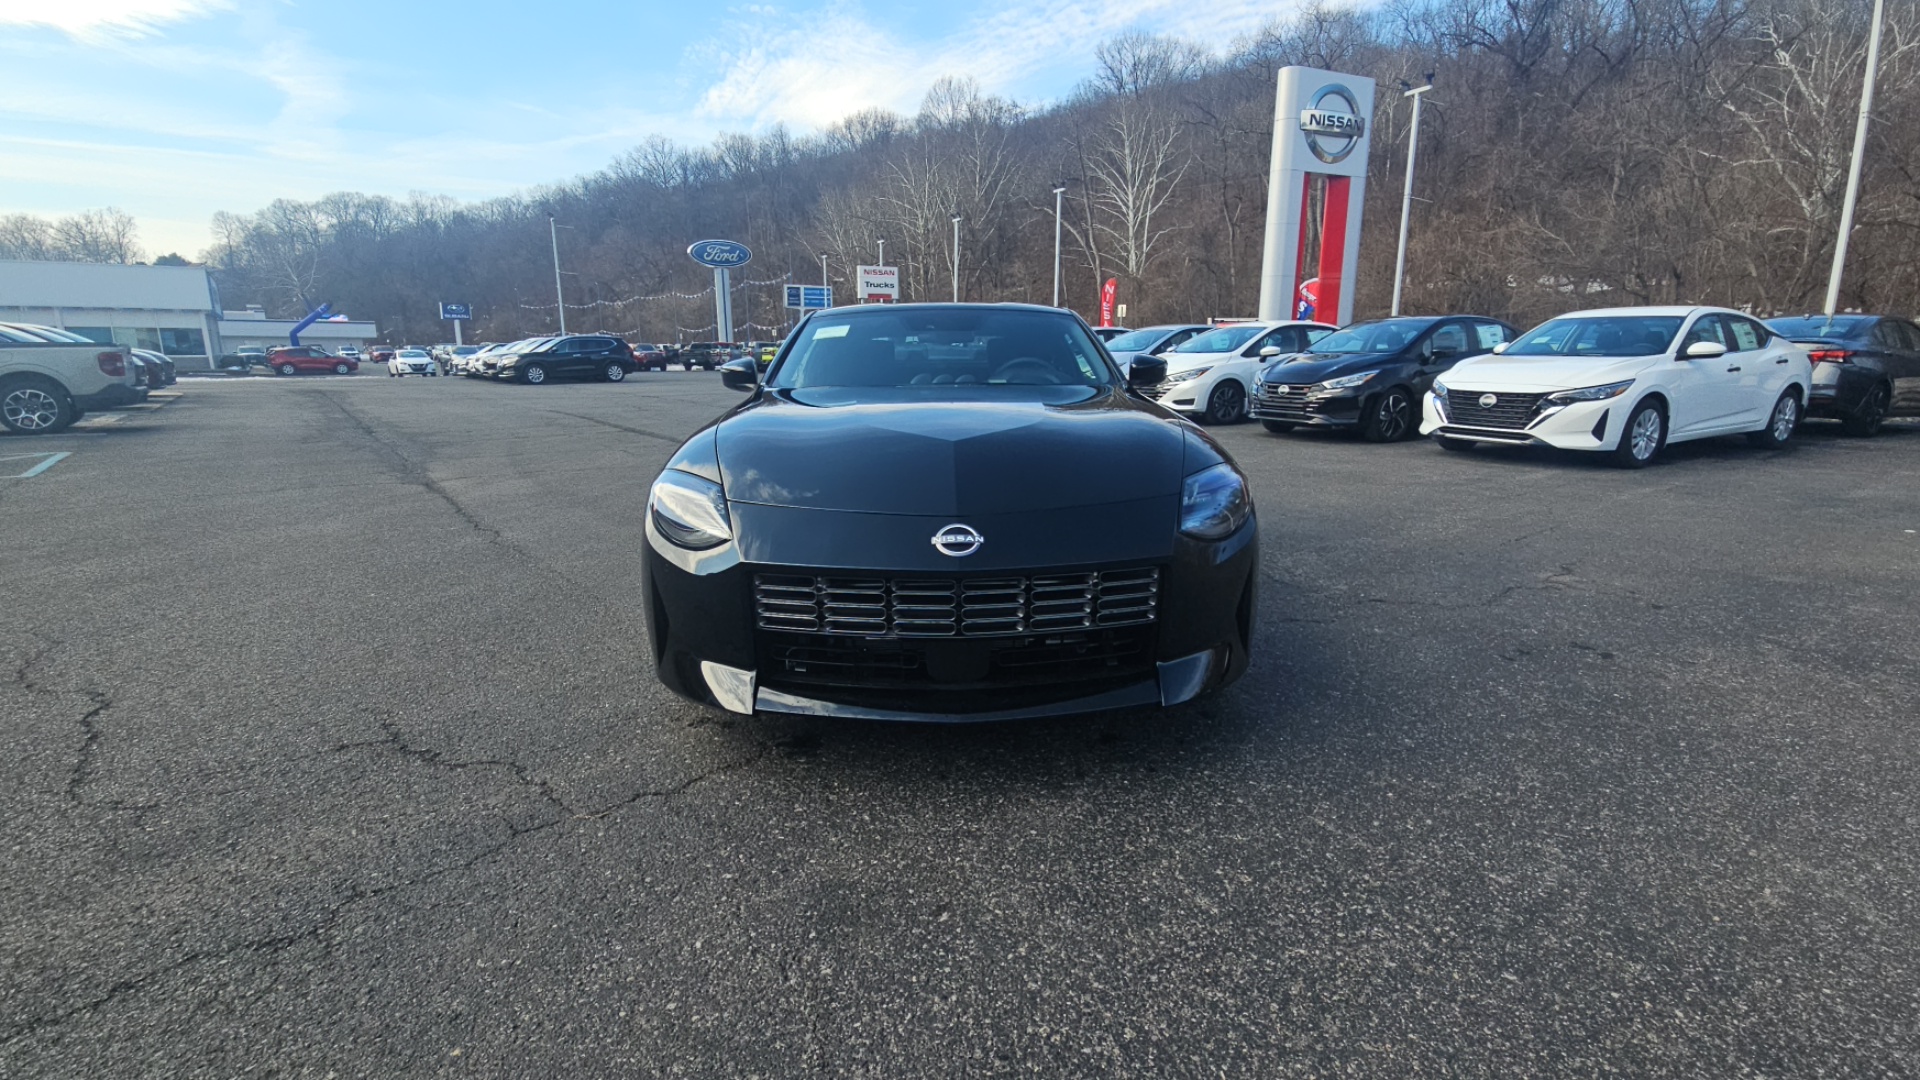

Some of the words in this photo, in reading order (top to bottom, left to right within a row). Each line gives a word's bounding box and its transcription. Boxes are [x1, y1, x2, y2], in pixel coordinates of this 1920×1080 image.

[1309, 113, 1361, 131] NISSAN
[703, 244, 741, 261] Ford
[863, 268, 895, 276] NISSAN
[864, 280, 895, 289] Trucks
[933, 535, 984, 543] NISSAN
